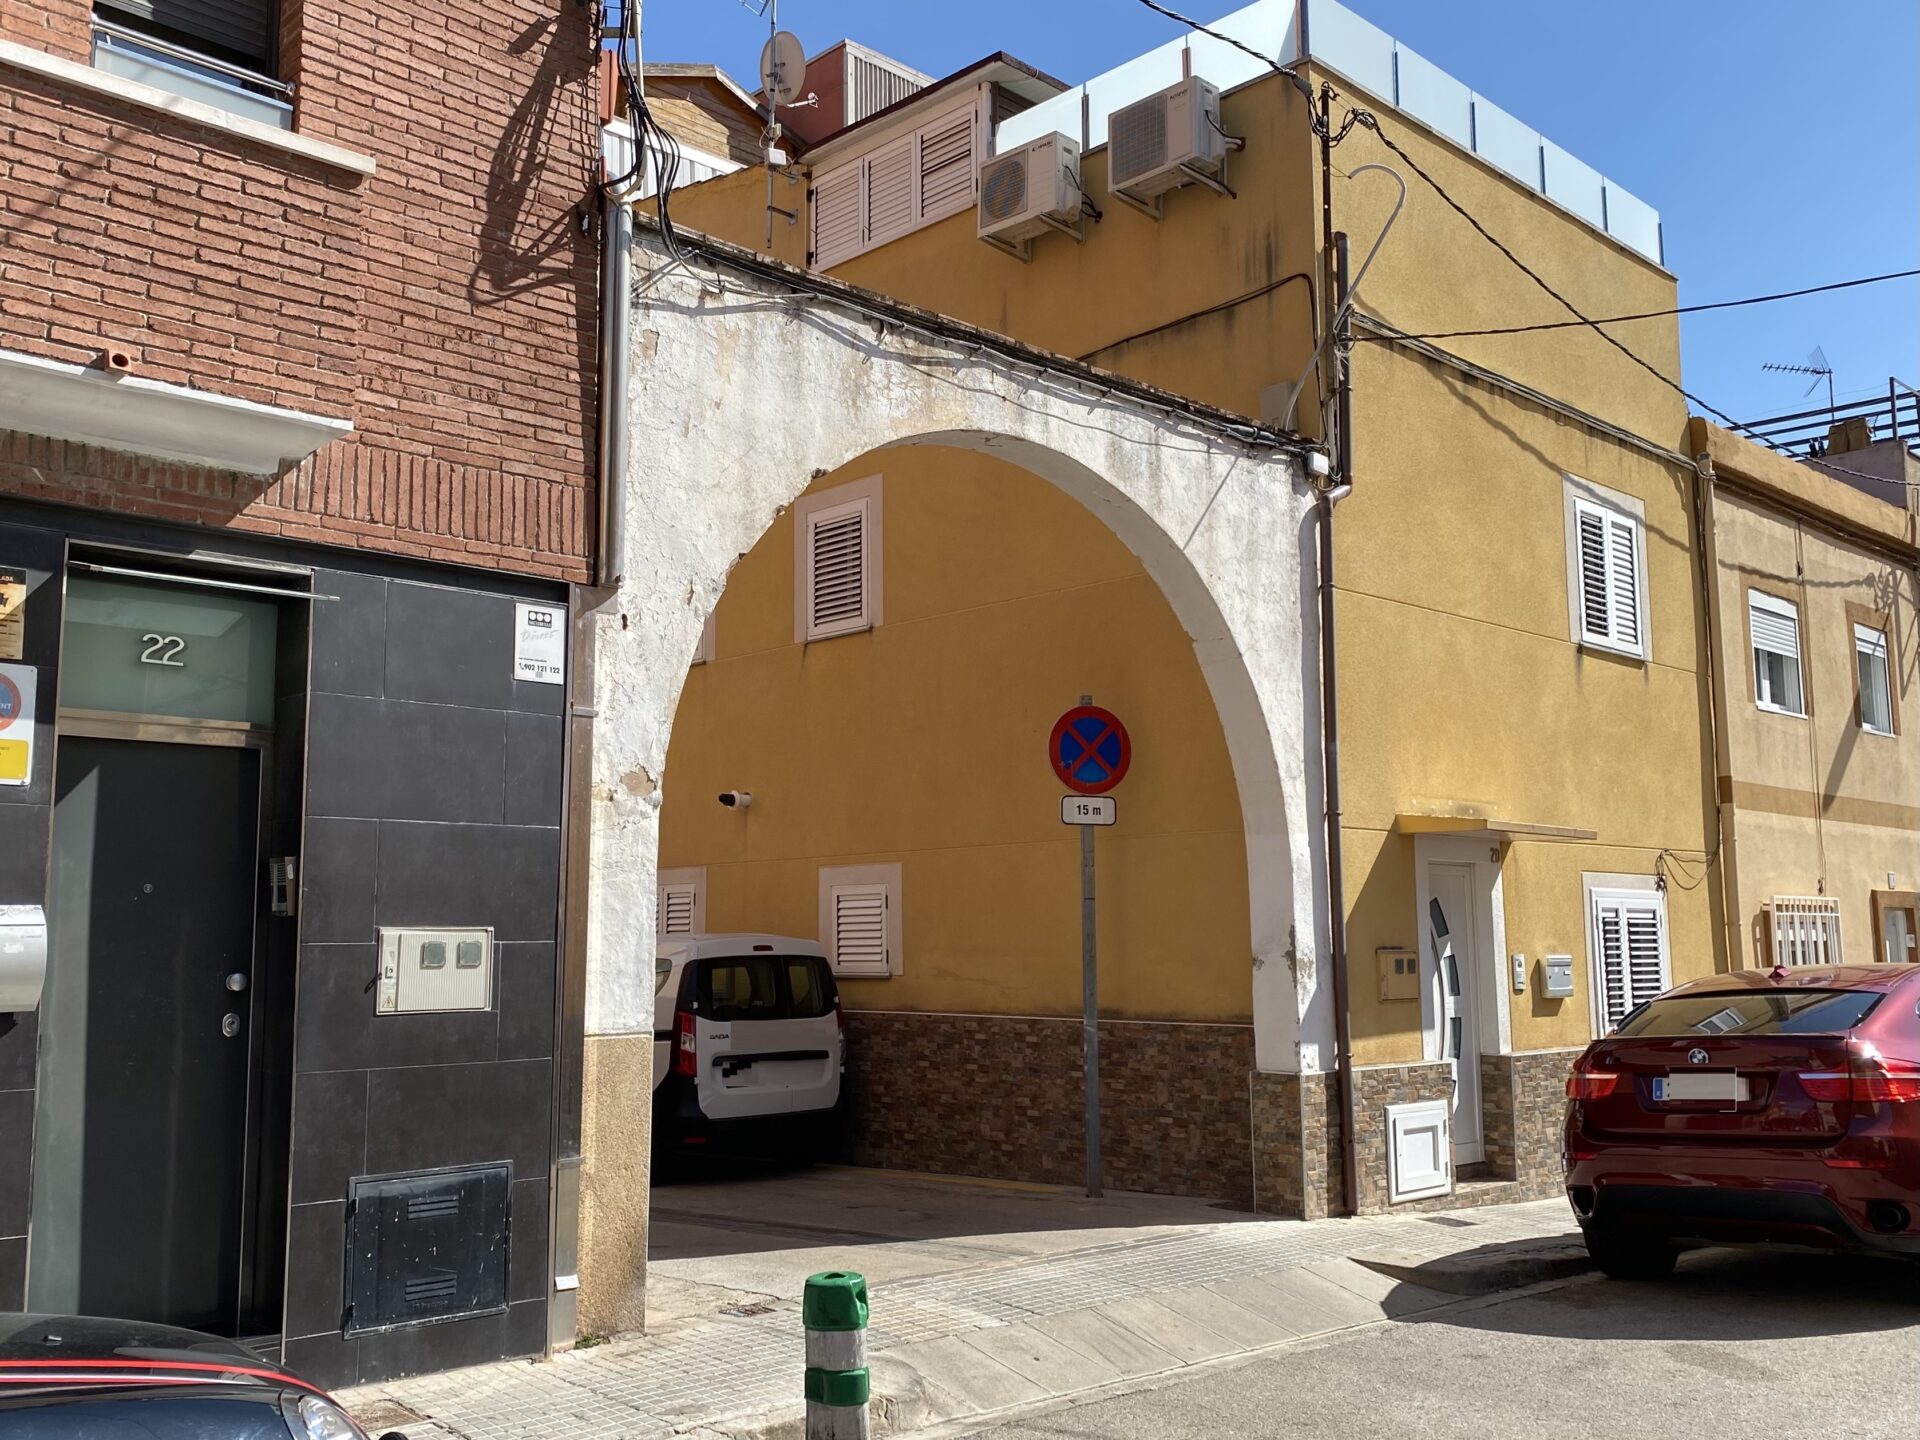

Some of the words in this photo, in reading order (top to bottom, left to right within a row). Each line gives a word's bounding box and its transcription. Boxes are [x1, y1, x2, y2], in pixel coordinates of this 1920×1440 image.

[141, 633, 185, 667] 22
[524, 663, 536, 671] 902
[537, 665, 547, 673] 121
[549, 666, 561, 674] 122
[1076, 804, 1089, 816] 15
[1092, 807, 1102, 816] m
